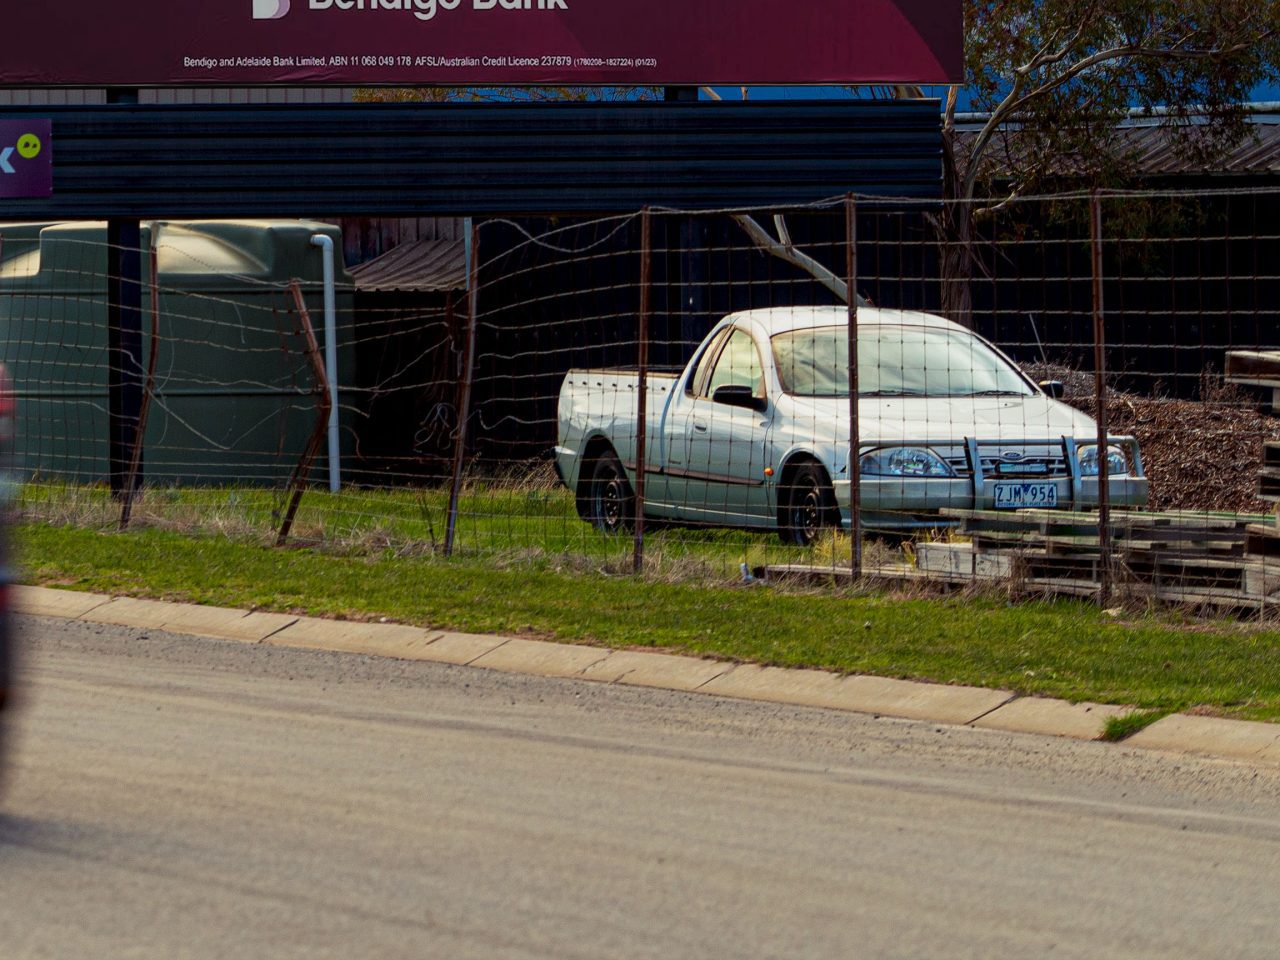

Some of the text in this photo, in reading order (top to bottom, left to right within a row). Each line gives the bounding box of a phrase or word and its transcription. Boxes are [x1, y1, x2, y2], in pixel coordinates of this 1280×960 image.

[183, 56, 218, 69] Bendigo
[219, 57, 235, 67] and
[235, 56, 271, 67] Adelaide
[272, 56, 294, 67] Bank
[296, 56, 328, 68] Limited,
[329, 56, 348, 66] ABN
[350, 56, 359, 66] 11
[361, 56, 377, 66] 068
[378, 56, 395, 66] 049
[396, 56, 412, 66] 178
[415, 56, 480, 67] AFSL/Australian
[481, 56, 507, 67] Credit
[508, 56, 539, 67] Licence
[541, 56, 572, 67] 237879
[635, 58, 657, 68] (01/23)
[997, 487, 1055, 502] ZJM 954
